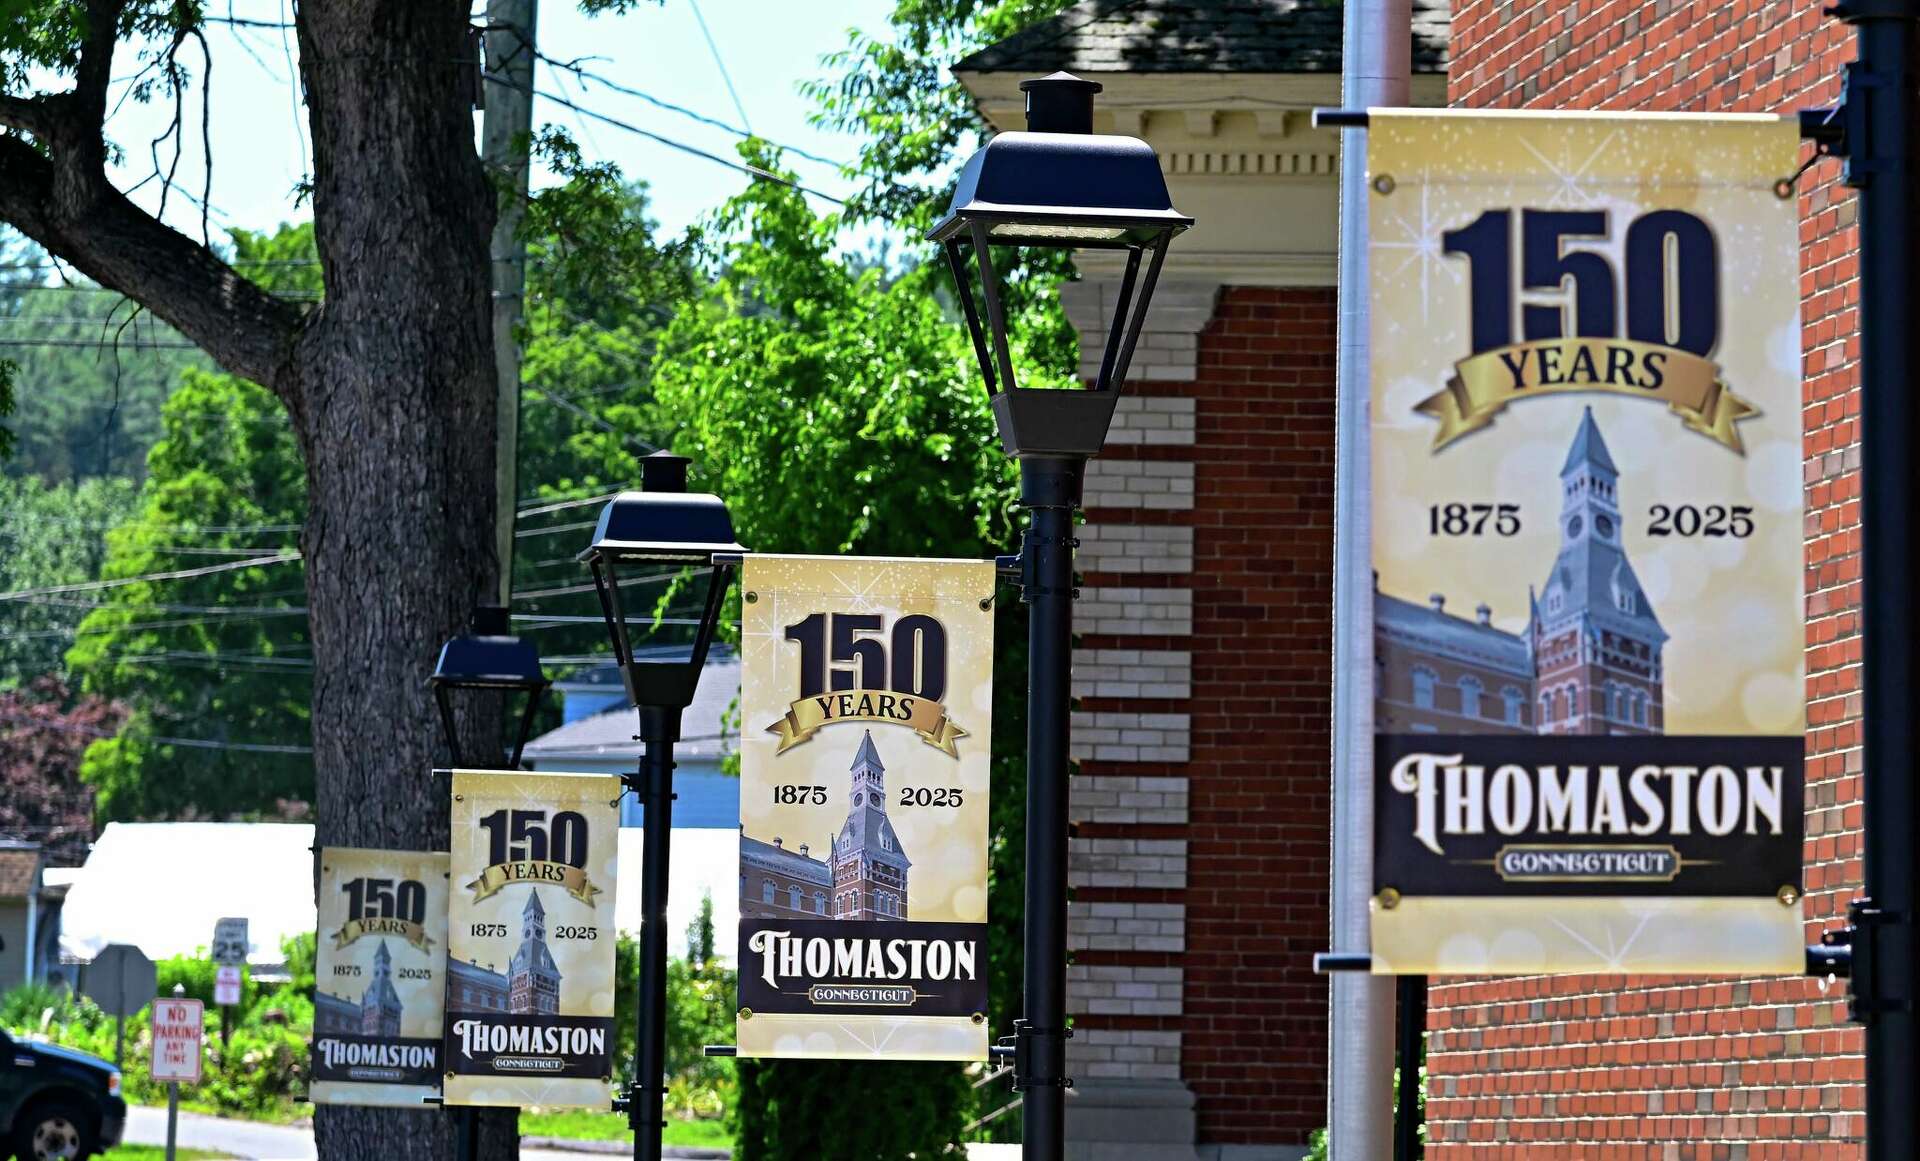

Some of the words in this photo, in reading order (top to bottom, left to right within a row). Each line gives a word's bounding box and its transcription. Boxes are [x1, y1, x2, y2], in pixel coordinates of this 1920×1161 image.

[1442, 207, 1719, 357] 150
[1500, 345, 1667, 390] YEARS
[1429, 503, 1521, 536] 1875
[1647, 505, 1754, 538] 2025
[784, 612, 947, 703] 150
[816, 693, 915, 721] YEARS
[773, 785, 828, 805] 1875
[900, 787, 964, 808] 2025
[1390, 753, 1784, 855] THOMASTON
[479, 809, 589, 869] 150
[500, 863, 566, 882] YEARS
[1504, 852, 1671, 874] CONNECTICUT
[341, 877, 427, 924] 150
[357, 920, 408, 934] YEARS
[471, 923, 508, 938] 1875
[555, 926, 597, 940] 2025
[749, 929, 977, 989] THOMASTON
[333, 965, 361, 977] 1875
[399, 967, 432, 980] 2025
[813, 988, 910, 1001] CONNECTICUT
[168, 1007, 187, 1021] NO
[155, 1023, 200, 1040] PARKING
[453, 1020, 605, 1059] THOMASTON
[164, 1053, 187, 1065] TIME
[166, 1042, 186, 1051] ANY
[317, 1038, 436, 1069] THOMASTON
